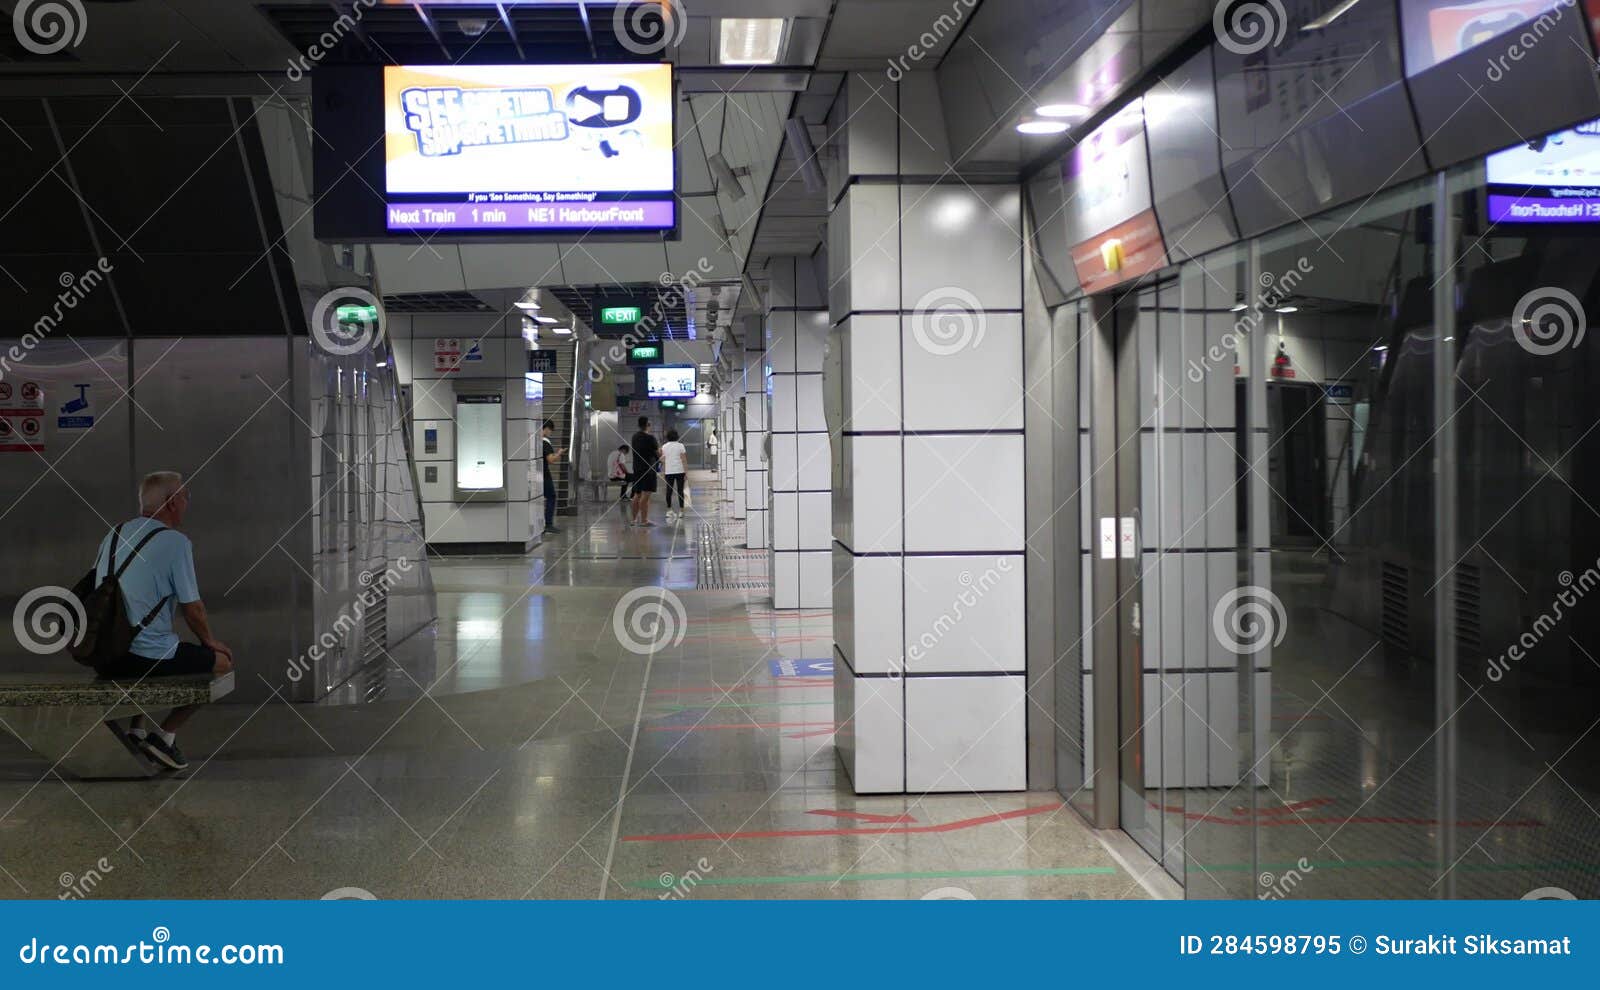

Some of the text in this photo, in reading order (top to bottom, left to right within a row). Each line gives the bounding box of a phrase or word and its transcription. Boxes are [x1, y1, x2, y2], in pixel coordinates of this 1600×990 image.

[475, 194, 488, 203] you
[390, 206, 644, 223] Next Train 1 min NE1 HarbourFront
[616, 309, 637, 322] EXIT
